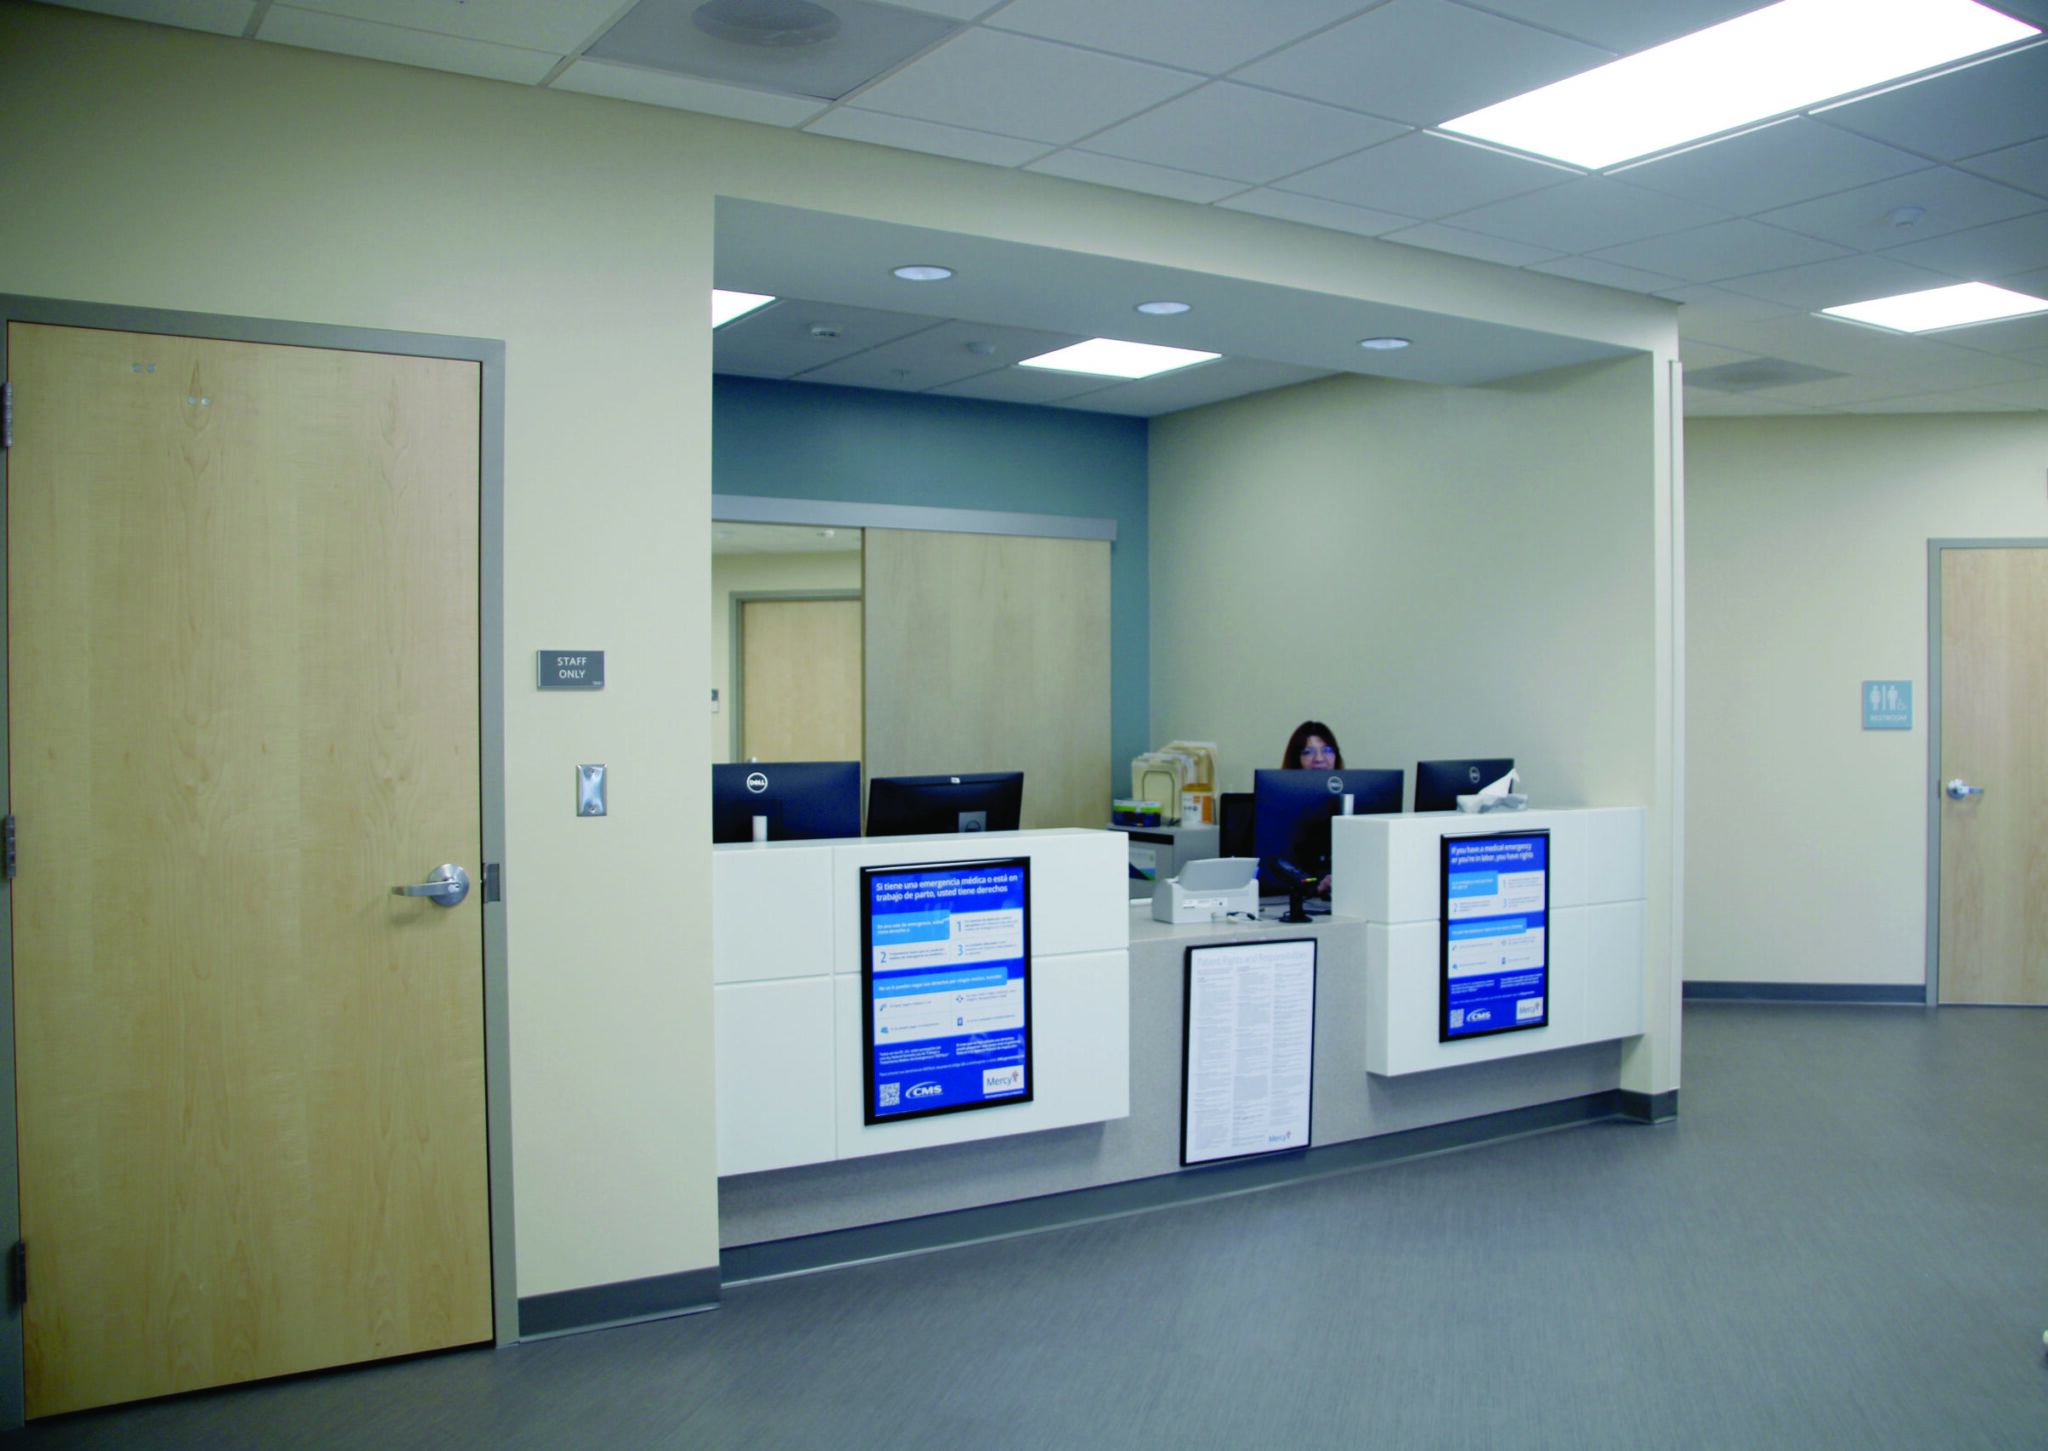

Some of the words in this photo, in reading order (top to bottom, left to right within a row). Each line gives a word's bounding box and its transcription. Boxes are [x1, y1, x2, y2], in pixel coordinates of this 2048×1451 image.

[557, 656, 587, 666] STAFF
[559, 669, 586, 679] ONLY
[1456, 847, 1466, 856] you
[1484, 844, 1504, 852] medical
[1505, 843, 1532, 852] emergency
[1496, 854, 1506, 862] you
[1520, 852, 1534, 860] rights
[876, 882, 883, 891] Si
[884, 882, 903, 890] tiene
[919, 878, 960, 889] emergencia
[961, 876, 986, 885] médica
[993, 874, 1007, 882] está
[876, 892, 903, 902] trabajo
[904, 891, 913, 900] de
[914, 890, 936, 900] parto,
[937, 888, 956, 897] usted
[958, 887, 975, 896] tiene
[976, 885, 1008, 894] derechos
[957, 922, 962, 932] 1
[958, 944, 963, 956] 3
[880, 951, 887, 963] 2
[986, 1076, 1012, 1086] Mercy
[913, 1085, 942, 1096] CMS
